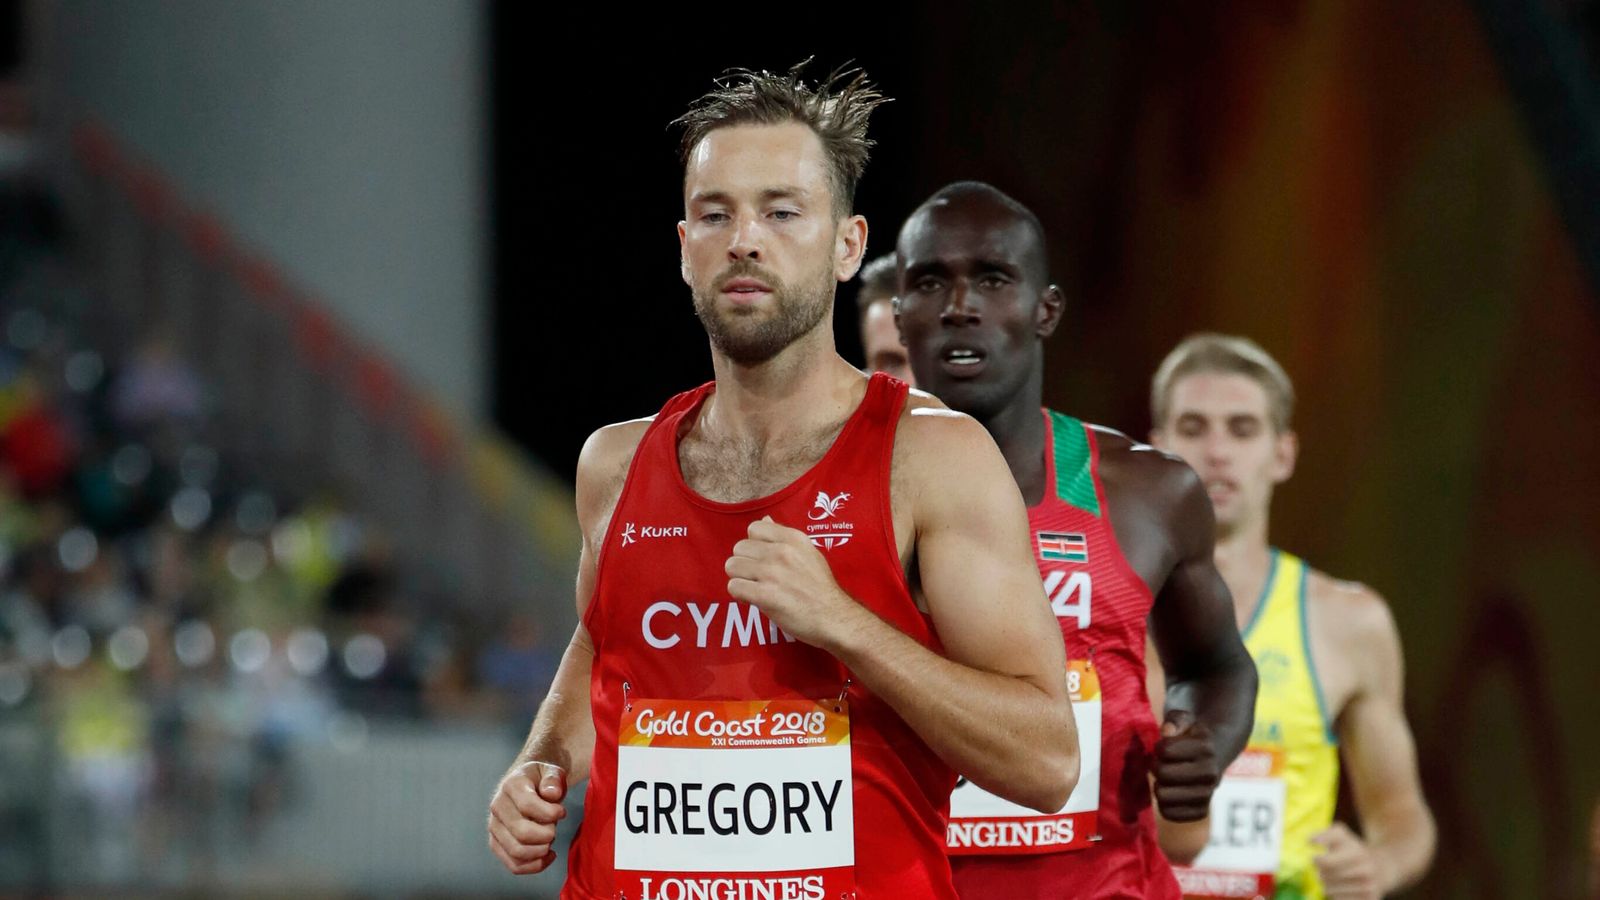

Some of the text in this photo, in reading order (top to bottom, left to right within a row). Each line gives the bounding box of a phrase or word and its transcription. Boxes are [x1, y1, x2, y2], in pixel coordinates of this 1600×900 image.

[640, 526, 688, 538] KUKRI
[806, 522, 854, 532] cymru wales
[635, 709, 826, 737] Gold Coast 2018
[711, 736, 827, 746] XXI Commonwealth Games
[623, 779, 843, 836] GREGORY
[640, 876, 825, 900] LONGINES
